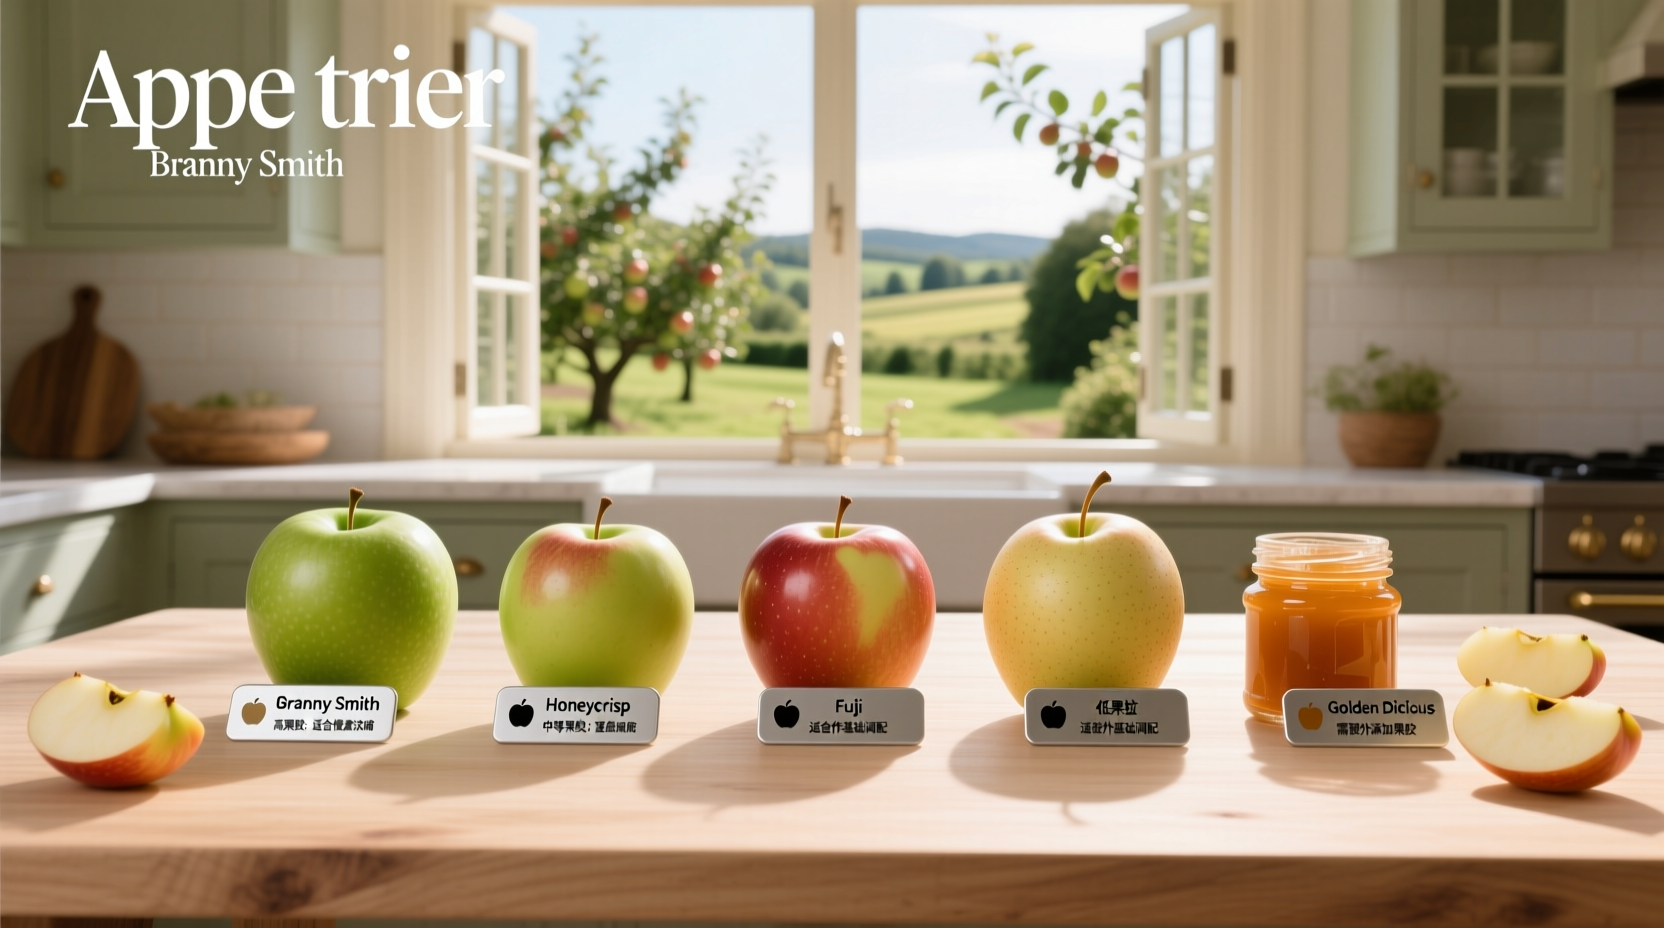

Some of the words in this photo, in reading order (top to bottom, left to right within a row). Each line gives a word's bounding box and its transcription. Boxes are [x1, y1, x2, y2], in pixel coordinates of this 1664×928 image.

[276, 695, 331, 714] Granny
[335, 696, 380, 711] Smith
[546, 697, 631, 716] Honeycrisp
[835, 698, 863, 717] Fuji
[1328, 700, 1379, 714] Golden
